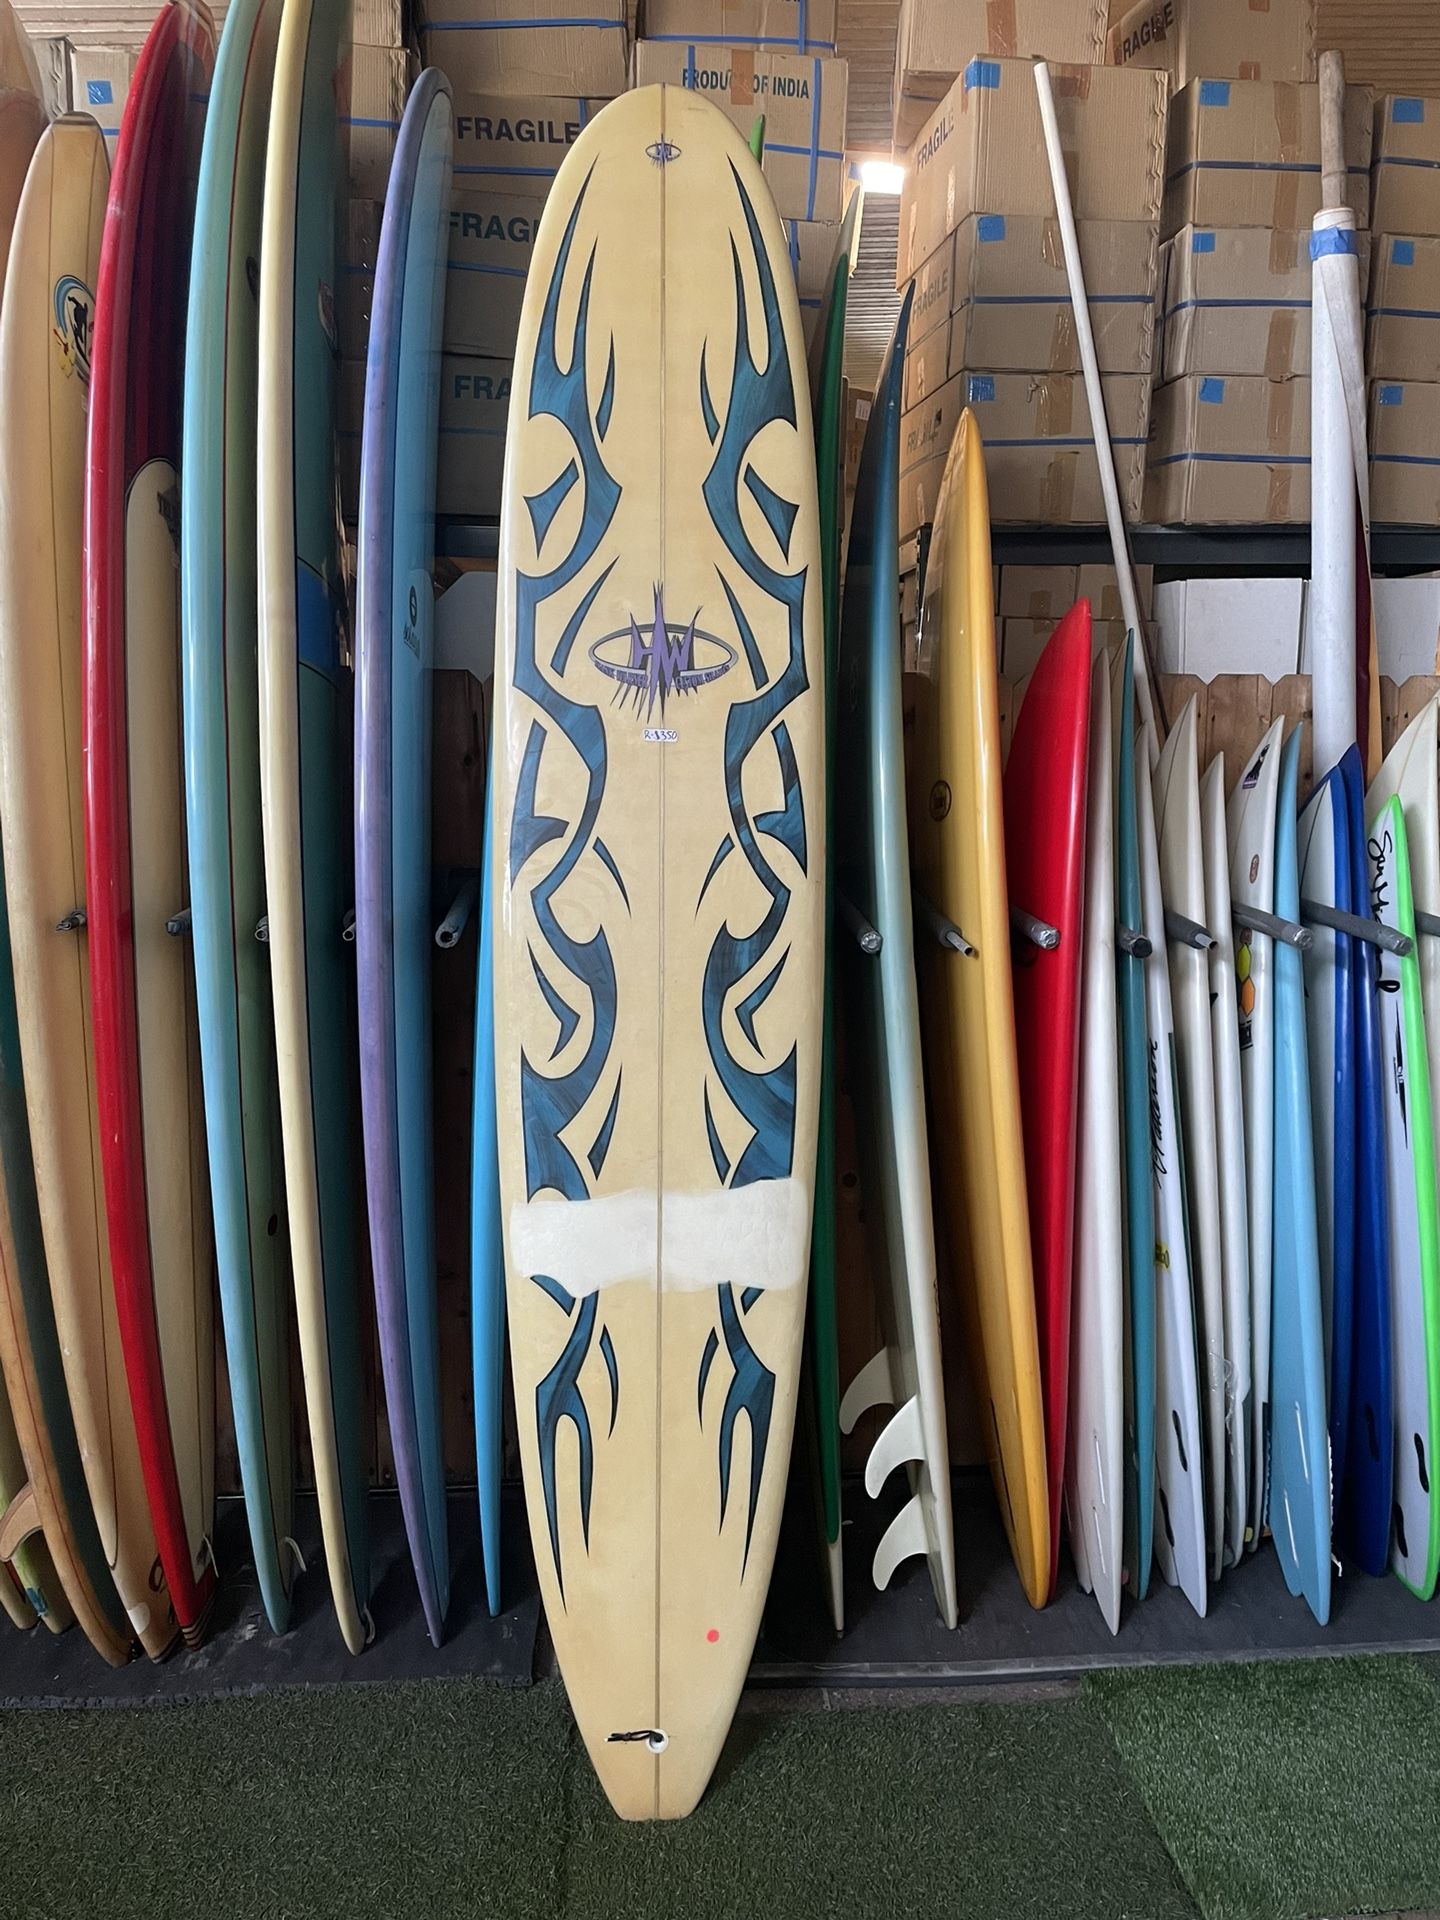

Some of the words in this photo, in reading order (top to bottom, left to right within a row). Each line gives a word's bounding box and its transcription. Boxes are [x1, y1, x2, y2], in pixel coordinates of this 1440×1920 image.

[682, 68, 732, 91] PRODU
[752, 73, 768, 94] OF
[773, 76, 809, 99] INDIA
[457, 116, 581, 144] FRAGILE
[917, 107, 954, 175] FRAGILE
